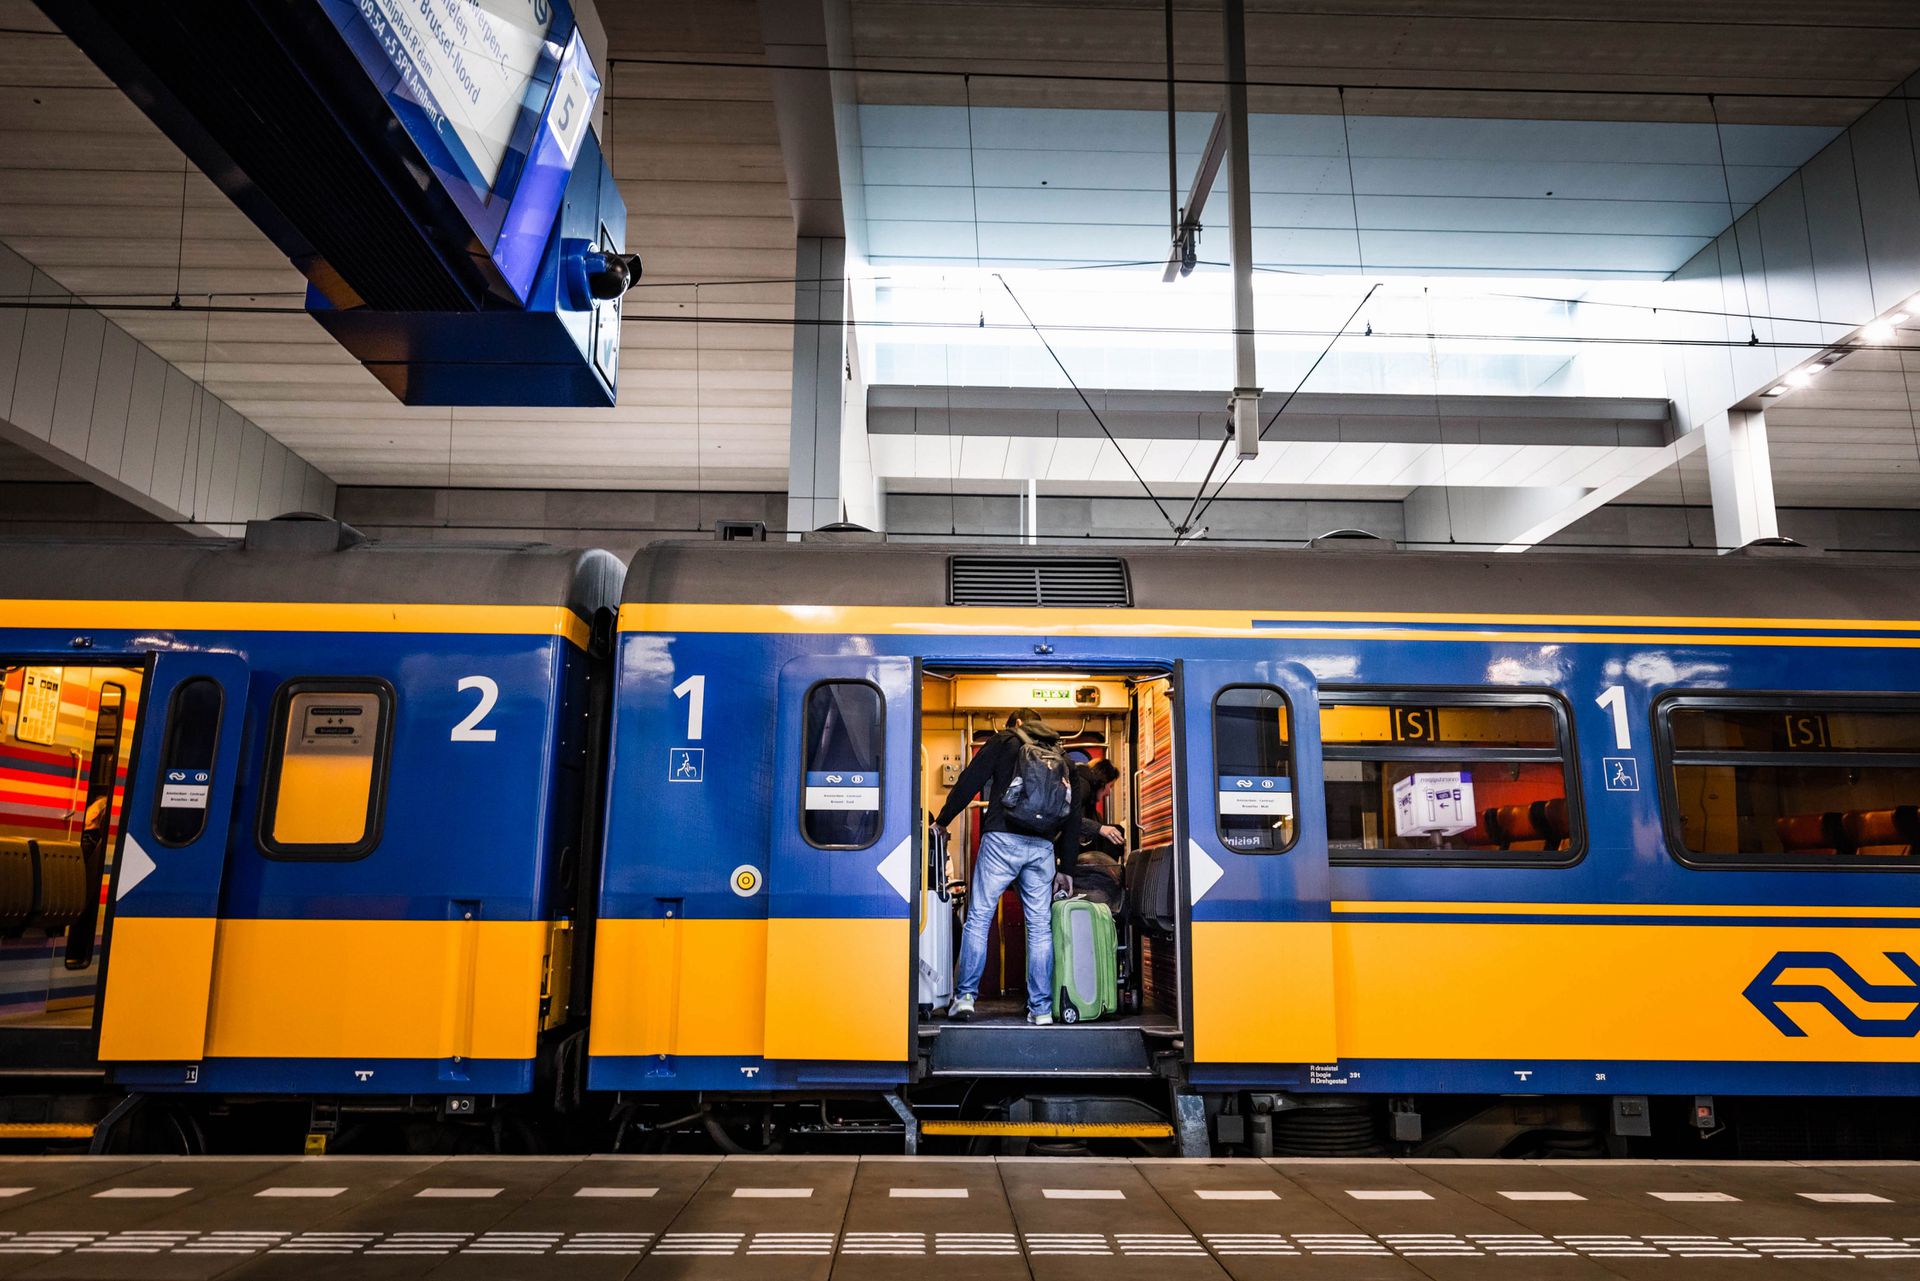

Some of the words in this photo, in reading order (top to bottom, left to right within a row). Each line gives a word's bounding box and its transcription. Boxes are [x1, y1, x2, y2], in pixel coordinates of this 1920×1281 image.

[360, 0, 386, 37] 09:54
[395, 48, 413, 80] SPR
[409, 75, 438, 122] Arnhem
[420, 0, 481, 105] Brussel-Noord
[558, 93, 575, 131] 5
[450, 675, 499, 742] 2
[672, 674, 706, 740] 1
[1595, 685, 1632, 750] 1
